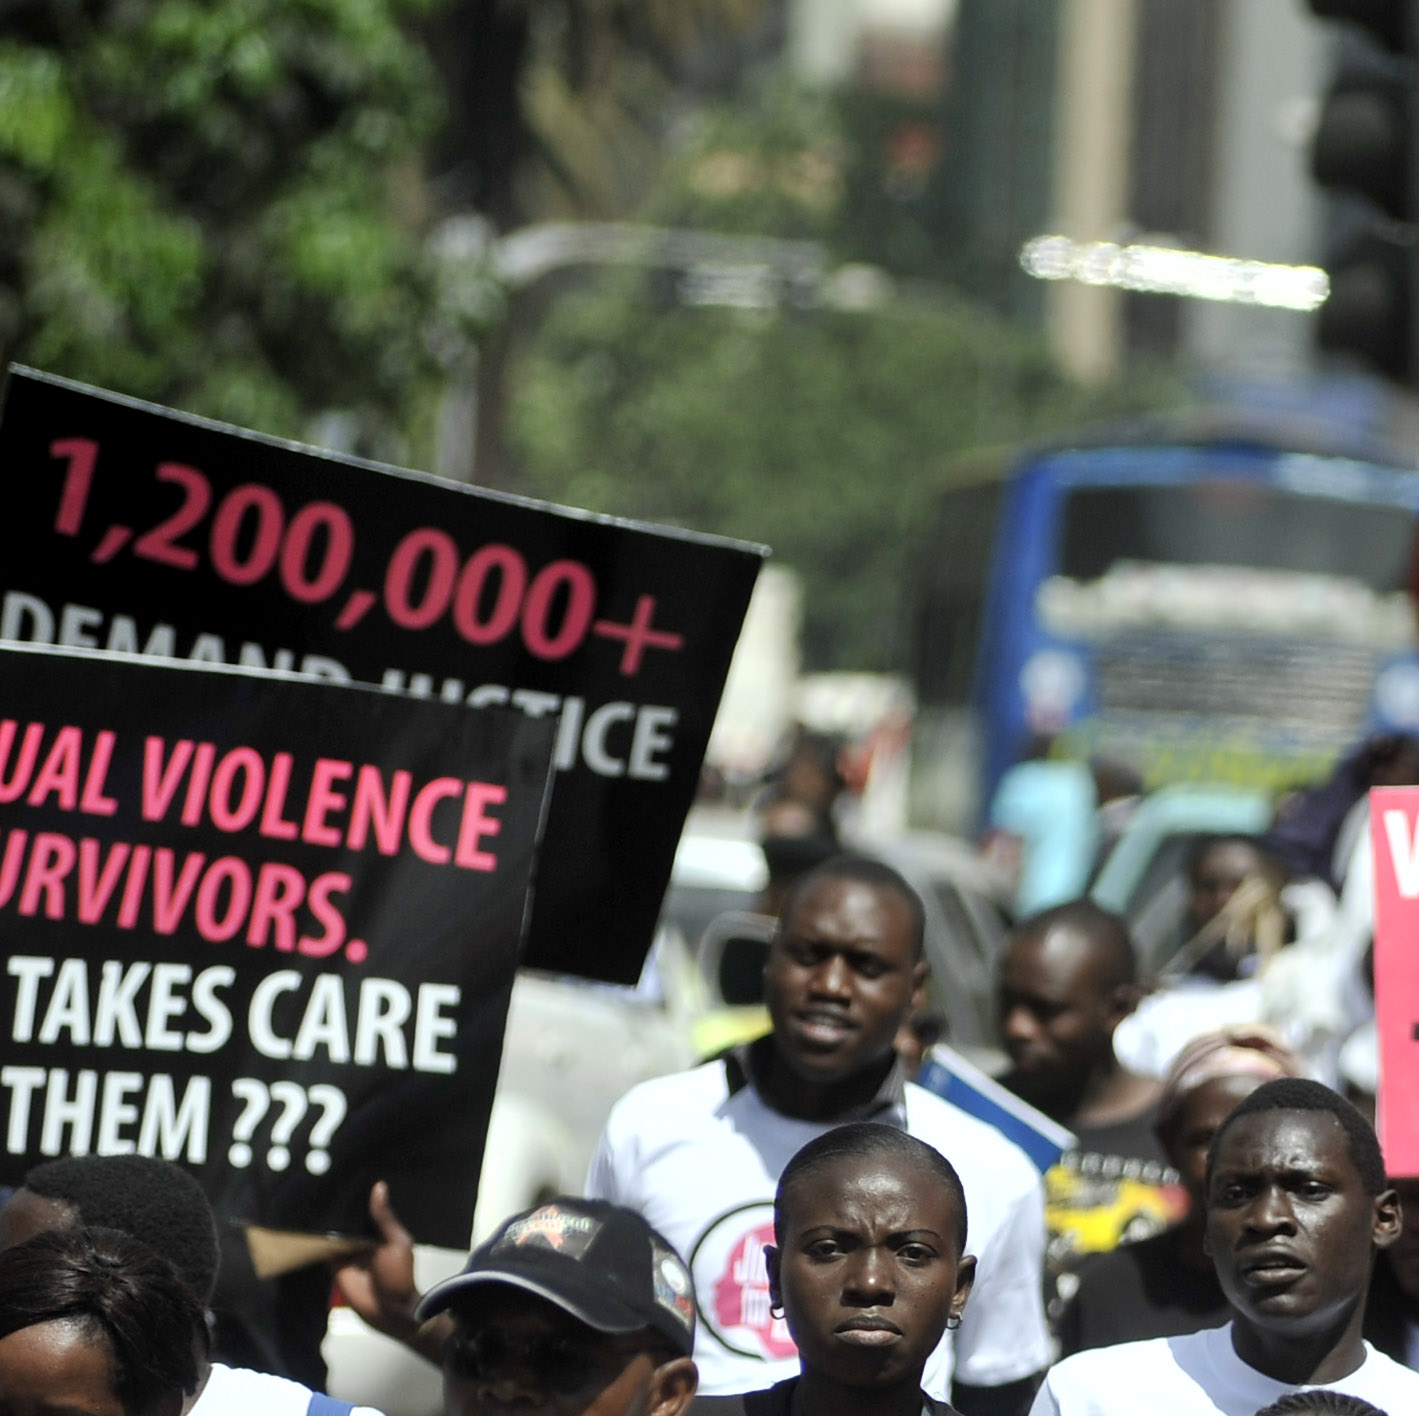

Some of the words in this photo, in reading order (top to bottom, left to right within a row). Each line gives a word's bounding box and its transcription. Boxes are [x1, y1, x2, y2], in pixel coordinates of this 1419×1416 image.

[49, 437, 684, 677] 1,200,000+
[141, 734, 508, 871] VIOLENCE
[6, 954, 237, 1055] TAKES
[247, 969, 463, 1075] CARE
[0, 1065, 212, 1166] THEM
[227, 1077, 349, 1177] ???
